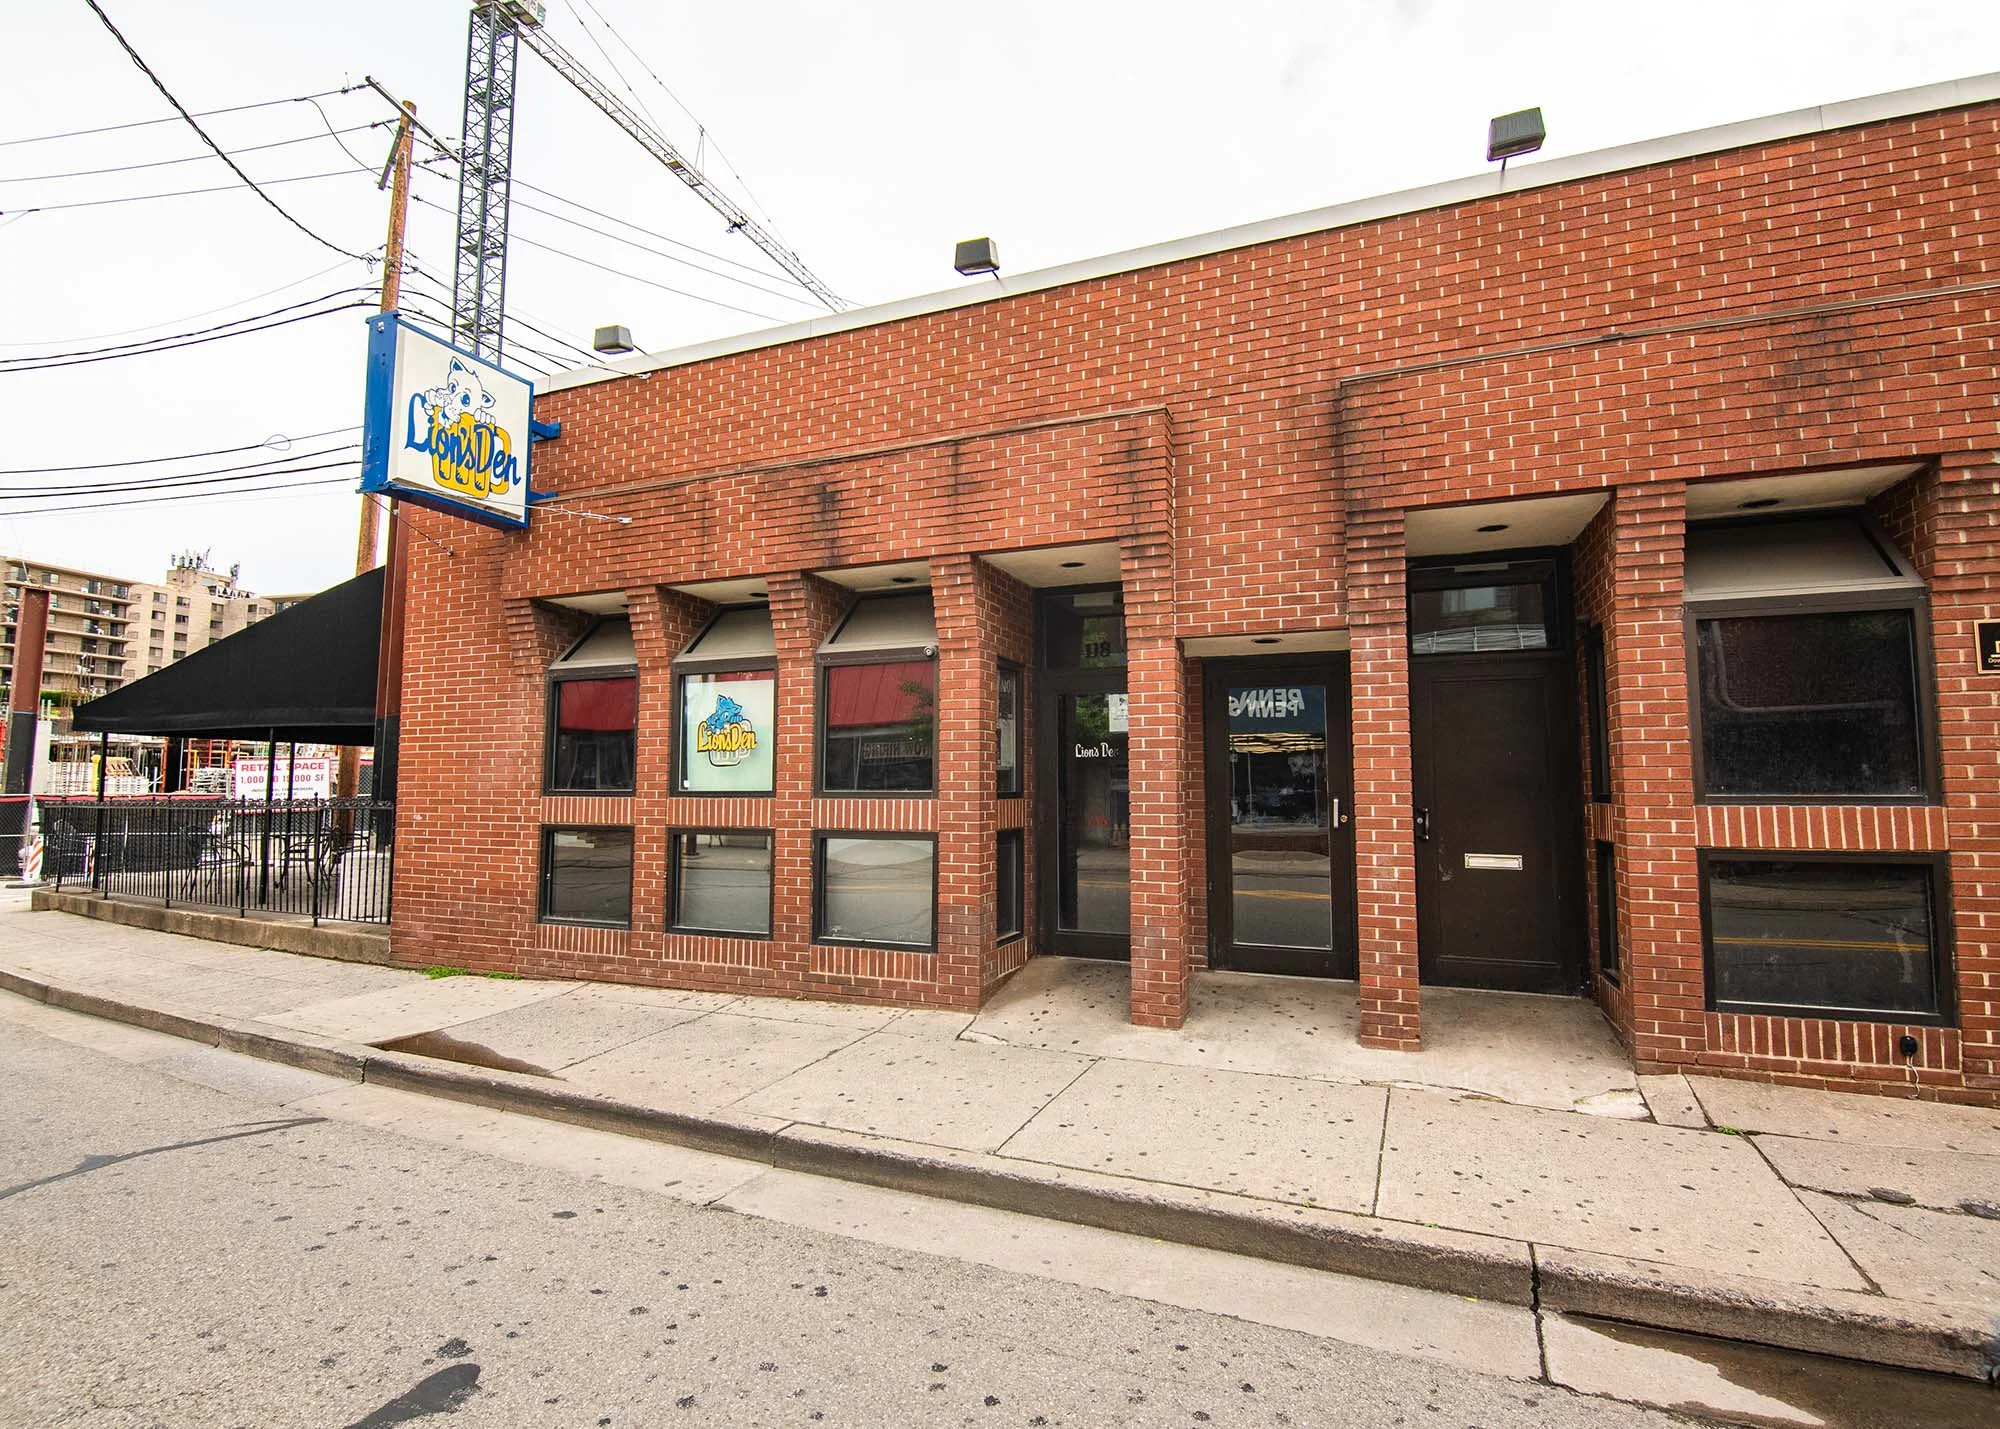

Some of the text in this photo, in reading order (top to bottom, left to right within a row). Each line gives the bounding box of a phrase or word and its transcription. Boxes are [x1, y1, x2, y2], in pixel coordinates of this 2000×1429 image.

[404, 393, 522, 487] Lion's Den
[697, 721, 758, 753] Lion's Den
[1075, 743, 1100, 758] Lion's
[241, 763, 282, 772] RETAL
